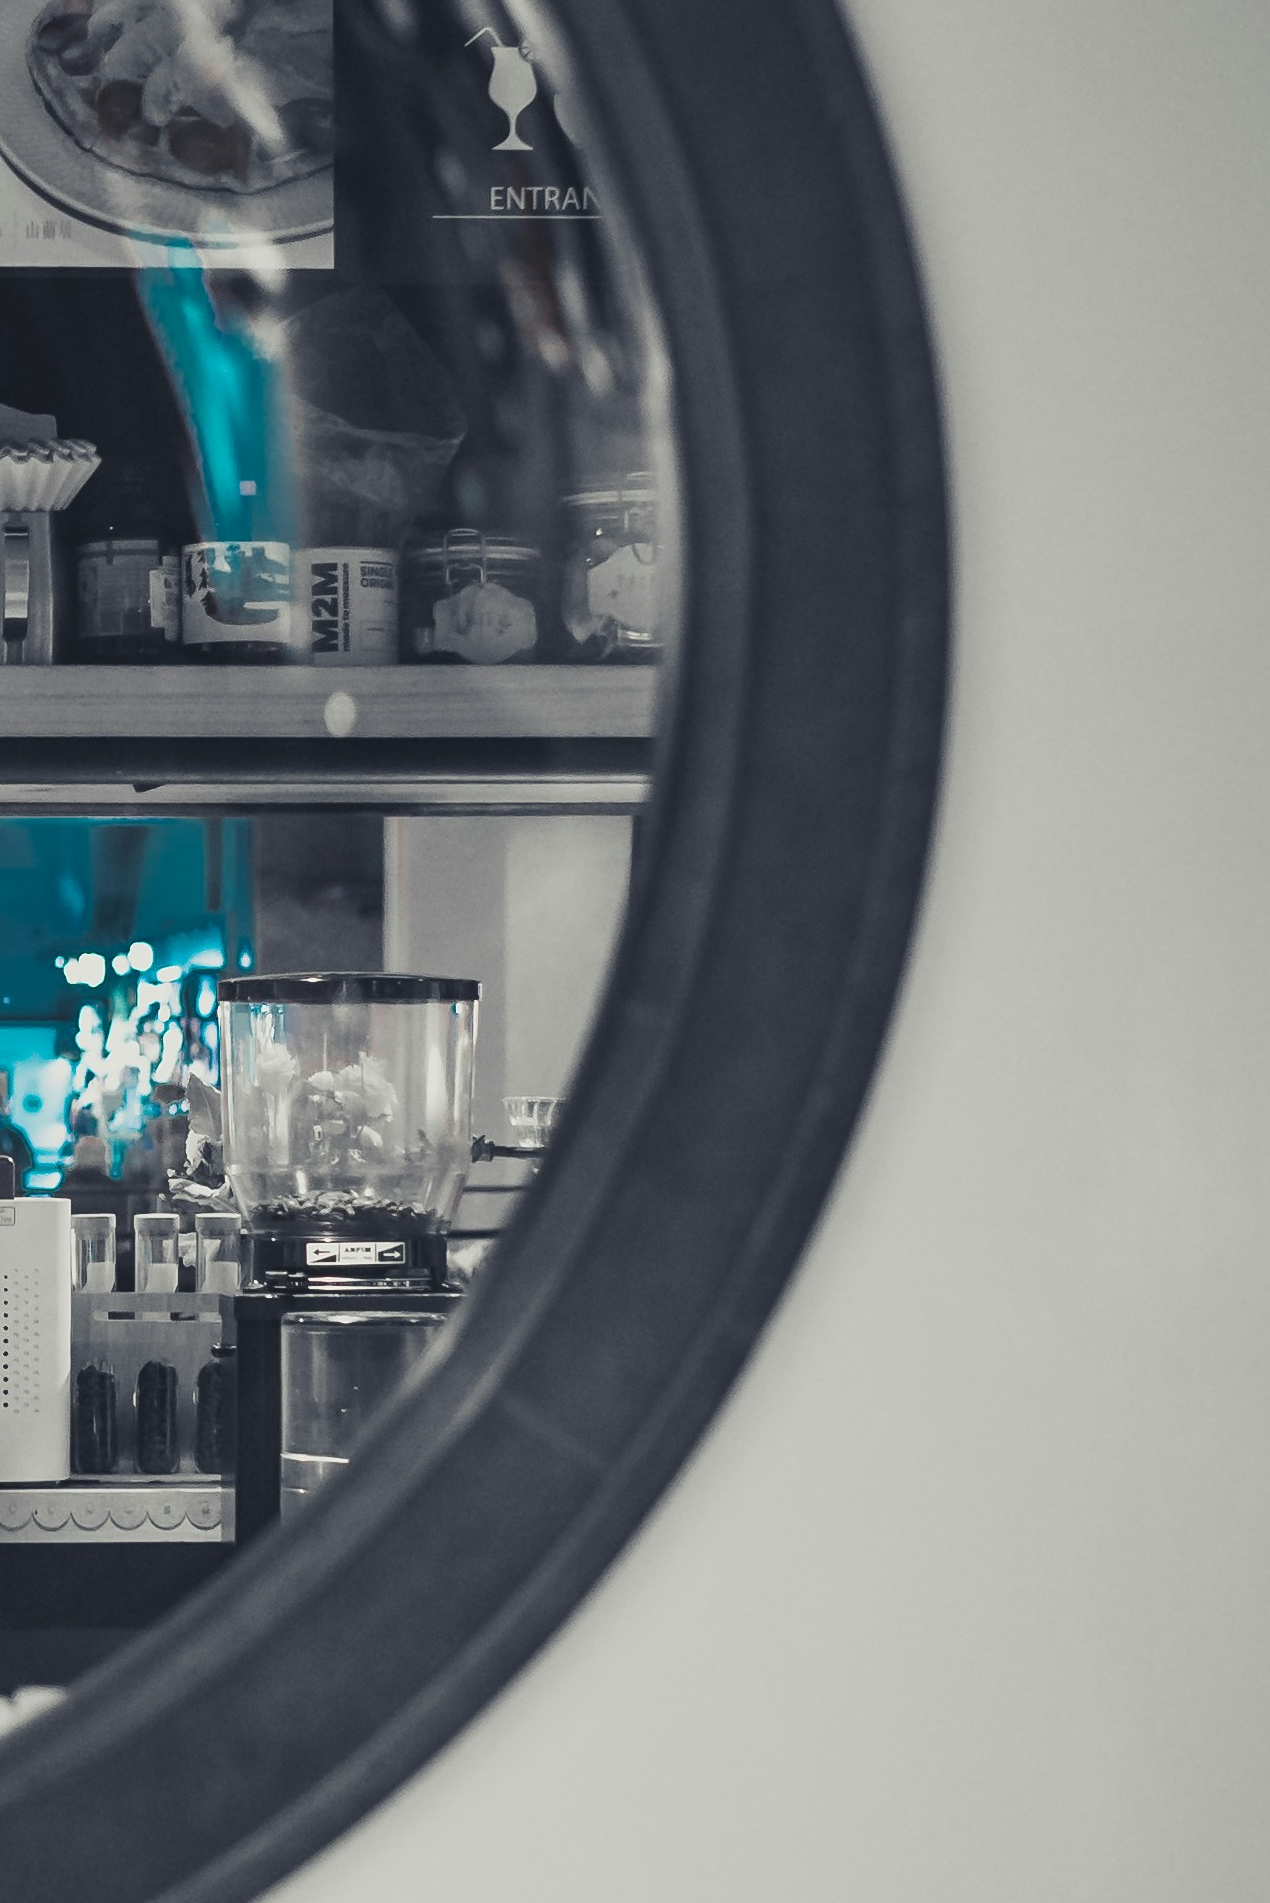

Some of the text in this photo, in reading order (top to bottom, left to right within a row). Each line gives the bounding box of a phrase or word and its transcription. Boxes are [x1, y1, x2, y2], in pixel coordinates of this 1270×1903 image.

[490, 186, 600, 210] ENTRAN
[360, 566, 394, 578] SINGL
[311, 562, 339, 653] M2M
